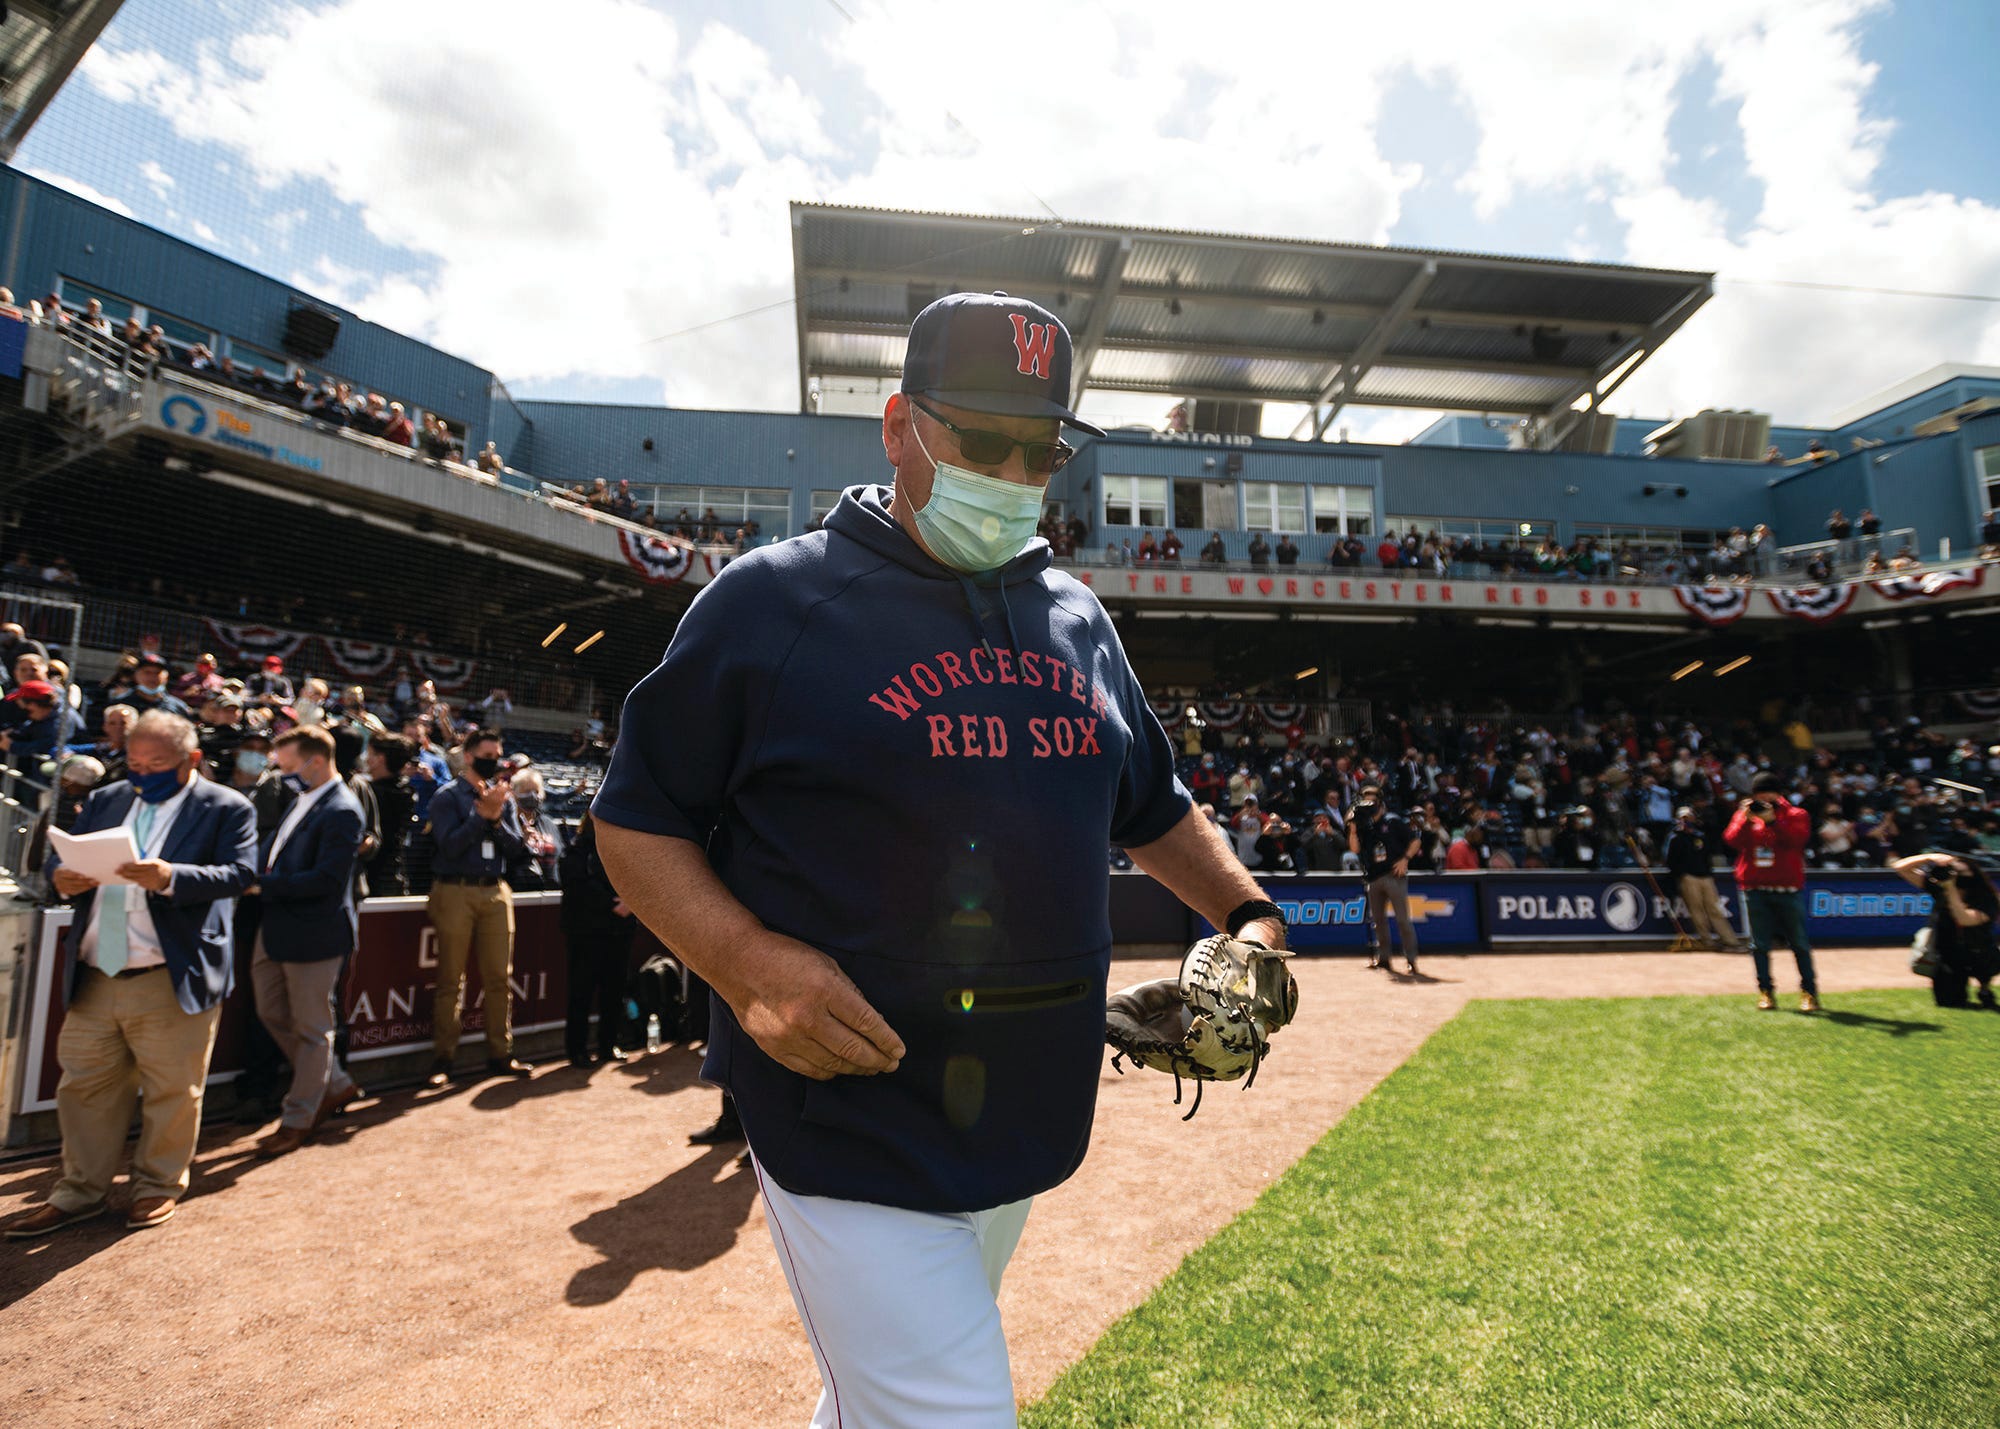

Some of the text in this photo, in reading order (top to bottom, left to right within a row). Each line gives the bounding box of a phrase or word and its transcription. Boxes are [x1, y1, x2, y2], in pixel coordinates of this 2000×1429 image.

[1008, 313, 1058, 379] W
[216, 409, 251, 434] The
[1128, 574, 1192, 594] THE
[1486, 587, 1548, 606] RED
[1579, 588, 1640, 608] SOX
[868, 647, 1107, 722] WORCESTER
[926, 714, 1101, 758] RED SOX
[1276, 895, 1367, 925] mond
[1498, 895, 1734, 920] POLAR PAK
